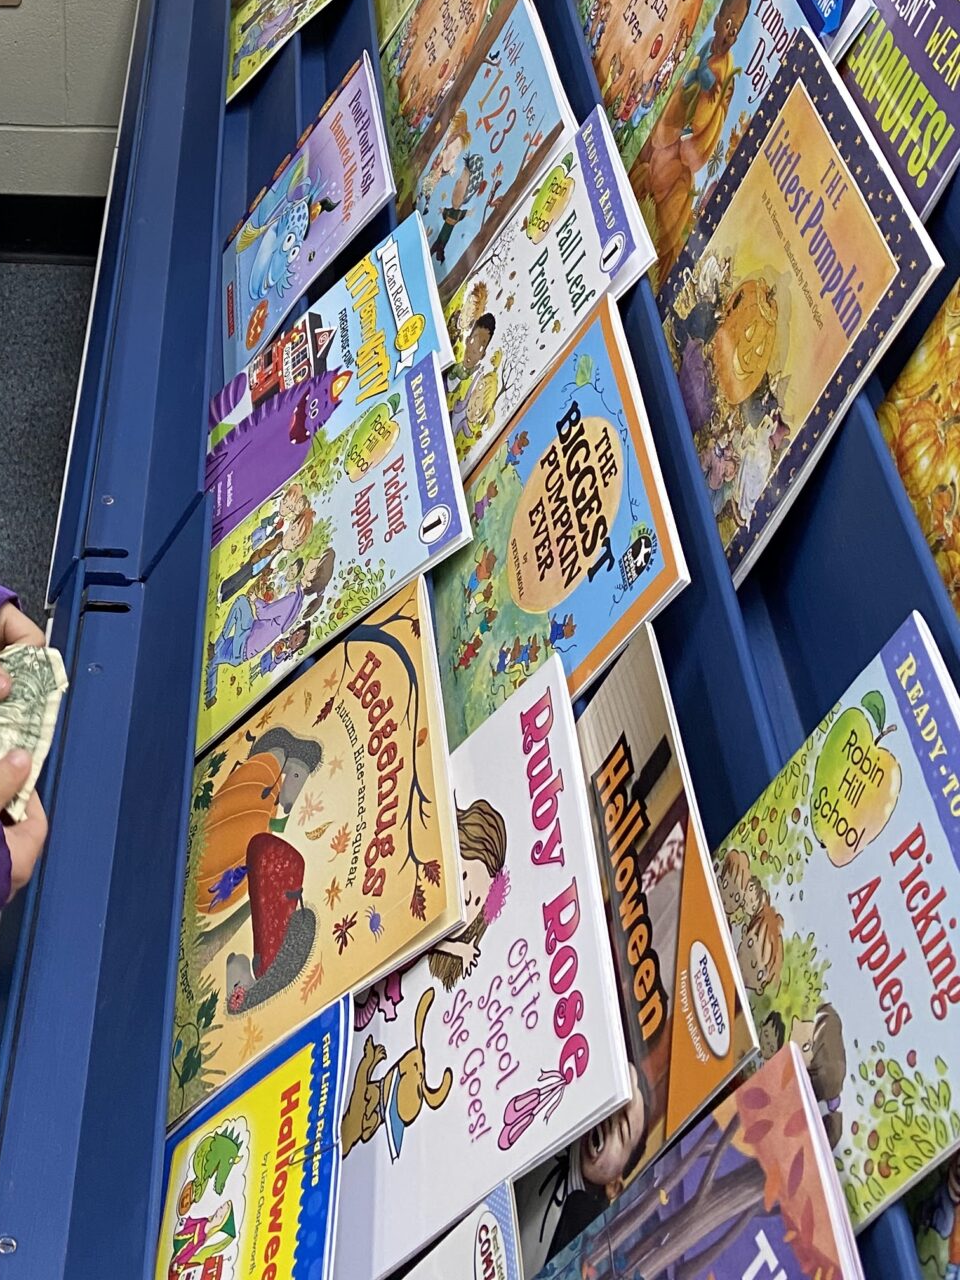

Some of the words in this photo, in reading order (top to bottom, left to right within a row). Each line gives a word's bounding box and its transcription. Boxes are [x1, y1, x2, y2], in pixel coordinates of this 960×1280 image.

[424, 27, 437, 67] Ever
[502, 20, 525, 67] Walk
[744, 38, 773, 104] Day
[514, 66, 533, 100] and
[522, 91, 537, 127] See
[846, 9, 955, 188] EARMUFFS!
[348, 88, 375, 162] Pout-Pout
[329, 111, 355, 168] Haunted
[342, 162, 358, 223] House
[361, 153, 376, 199] Fish
[550, 176, 568, 197] Robin
[820, 158, 849, 211] THE
[528, 211, 555, 233] School
[556, 209, 583, 265] Fall
[601, 236, 620, 266] 1
[763, 117, 815, 225] Littlest
[800, 197, 863, 340] Pumpkin
[385, 266, 397, 291] Can
[391, 287, 411, 322] Read!
[528, 246, 560, 333] Project
[565, 249, 596, 317] Leaf
[338, 307, 351, 353] FIREHOUSE
[355, 328, 391, 406] KITTY
[346, 444, 373, 472] School
[363, 434, 379, 452] Hill
[371, 414, 392, 441] Robin
[410, 372, 440, 499] READY-TO-READ
[595, 427, 618, 488] THE
[351, 482, 379, 556] Apples
[383, 454, 409, 543] Picking
[540, 445, 583, 589] PUMPKIN
[556, 400, 615, 583] BIGGEST
[422, 513, 443, 537] 1
[510, 537, 521, 576] STEVEN
[528, 497, 555, 582] EVER
[515, 573, 524, 601] KROLL
[334, 699, 359, 750] Autumn
[346, 650, 405, 898] Hedgehugs
[520, 686, 566, 868] Ruby
[838, 767, 866, 808] Hill
[841, 729, 884, 789] Robin
[345, 744, 367, 890] Hide-and-Squeak
[814, 786, 866, 853] School
[596, 741, 664, 1043] Halloween
[890, 822, 960, 1021] Picking
[507, 938, 542, 997] Off
[542, 876, 590, 1085] Rose
[848, 876, 913, 1038] Apples
[521, 992, 541, 1030] to
[679, 968, 690, 1013] Happy
[685, 1009, 710, 1065] Holidays!
[693, 969, 716, 1037] Readers
[699, 953, 726, 1036] PowerKiDS
[322, 1032, 332, 1068] First
[477, 975, 521, 1091] School
[316, 1071, 330, 1117] Little
[442, 988, 473, 1049] She
[460, 1047, 493, 1145] Goes!
[258, 1167, 267, 1195] Liza
[248, 1195, 265, 1276] Charlesworth
